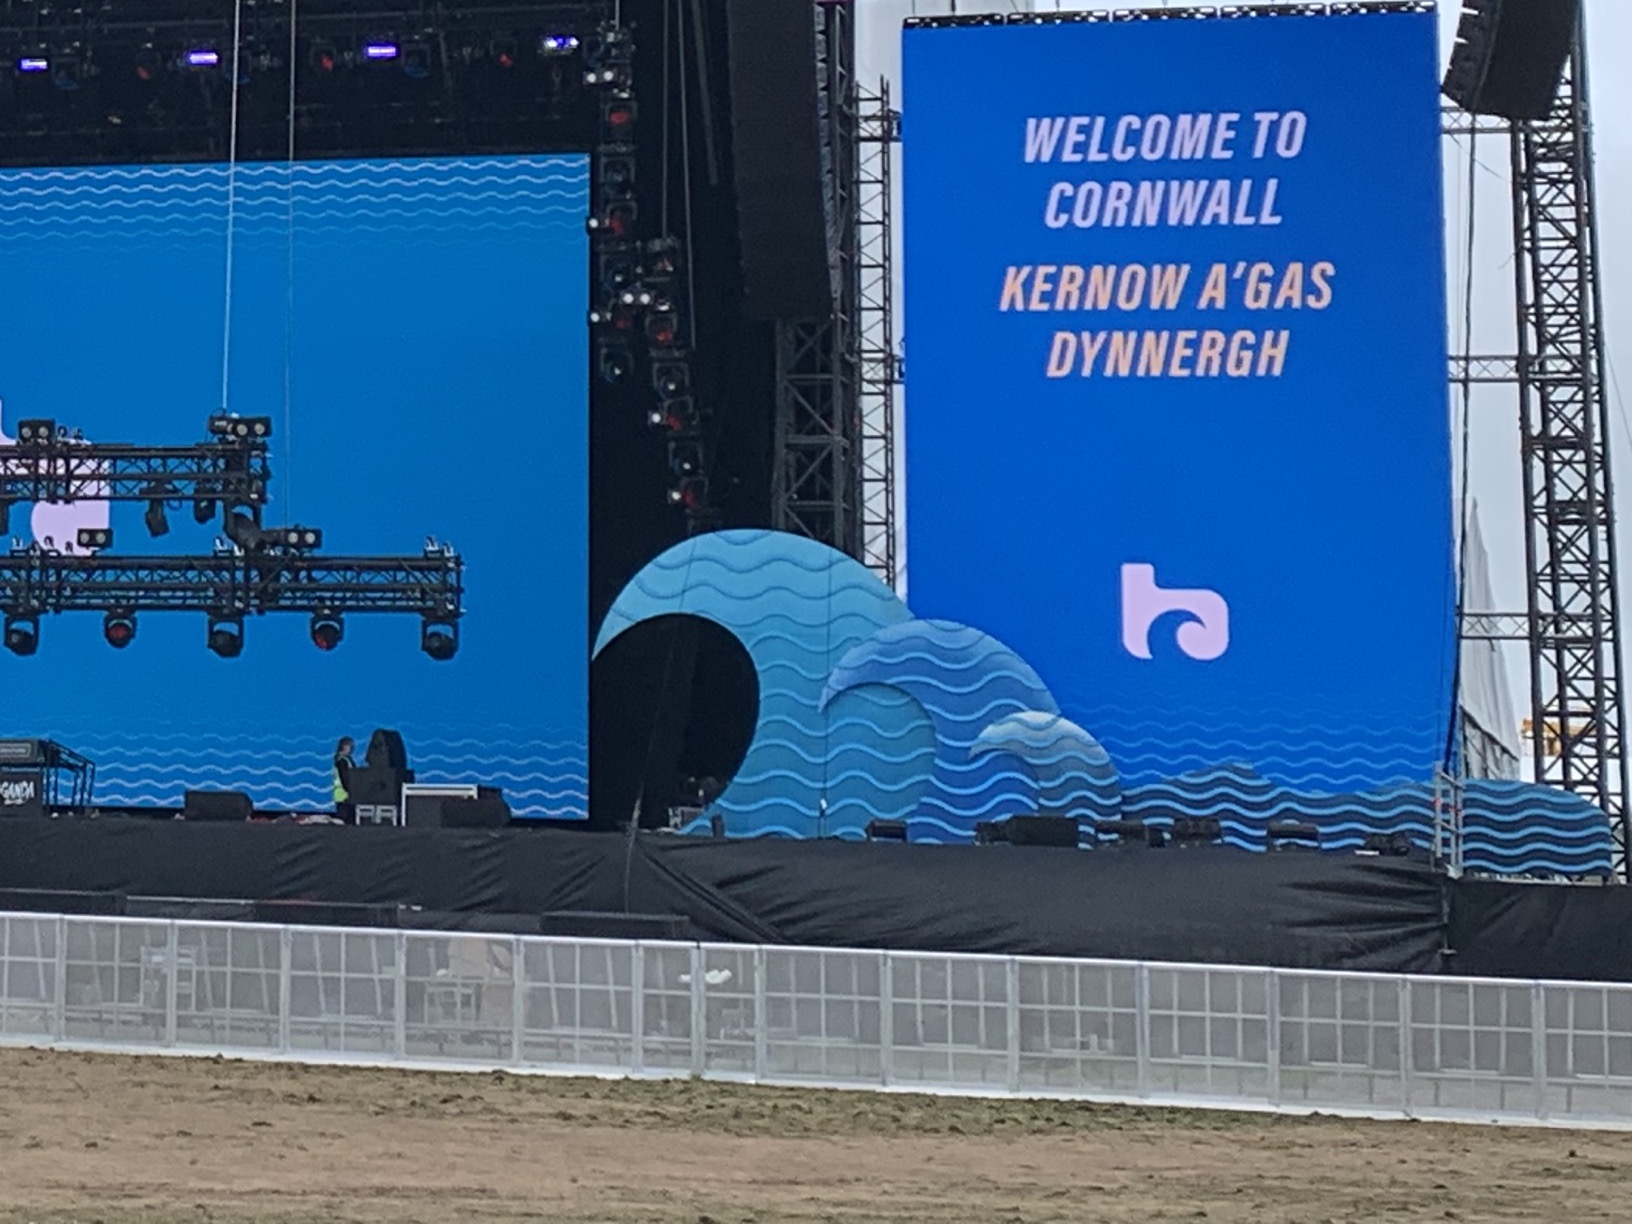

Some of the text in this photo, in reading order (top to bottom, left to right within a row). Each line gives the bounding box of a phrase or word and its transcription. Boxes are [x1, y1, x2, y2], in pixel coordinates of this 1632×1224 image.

[1023, 110, 1308, 164] WELCOME TO
[1044, 177, 1283, 229] CORNWALL
[999, 261, 1336, 312] KERNOW A'GAS
[1046, 329, 1290, 378] DYNNERGH
